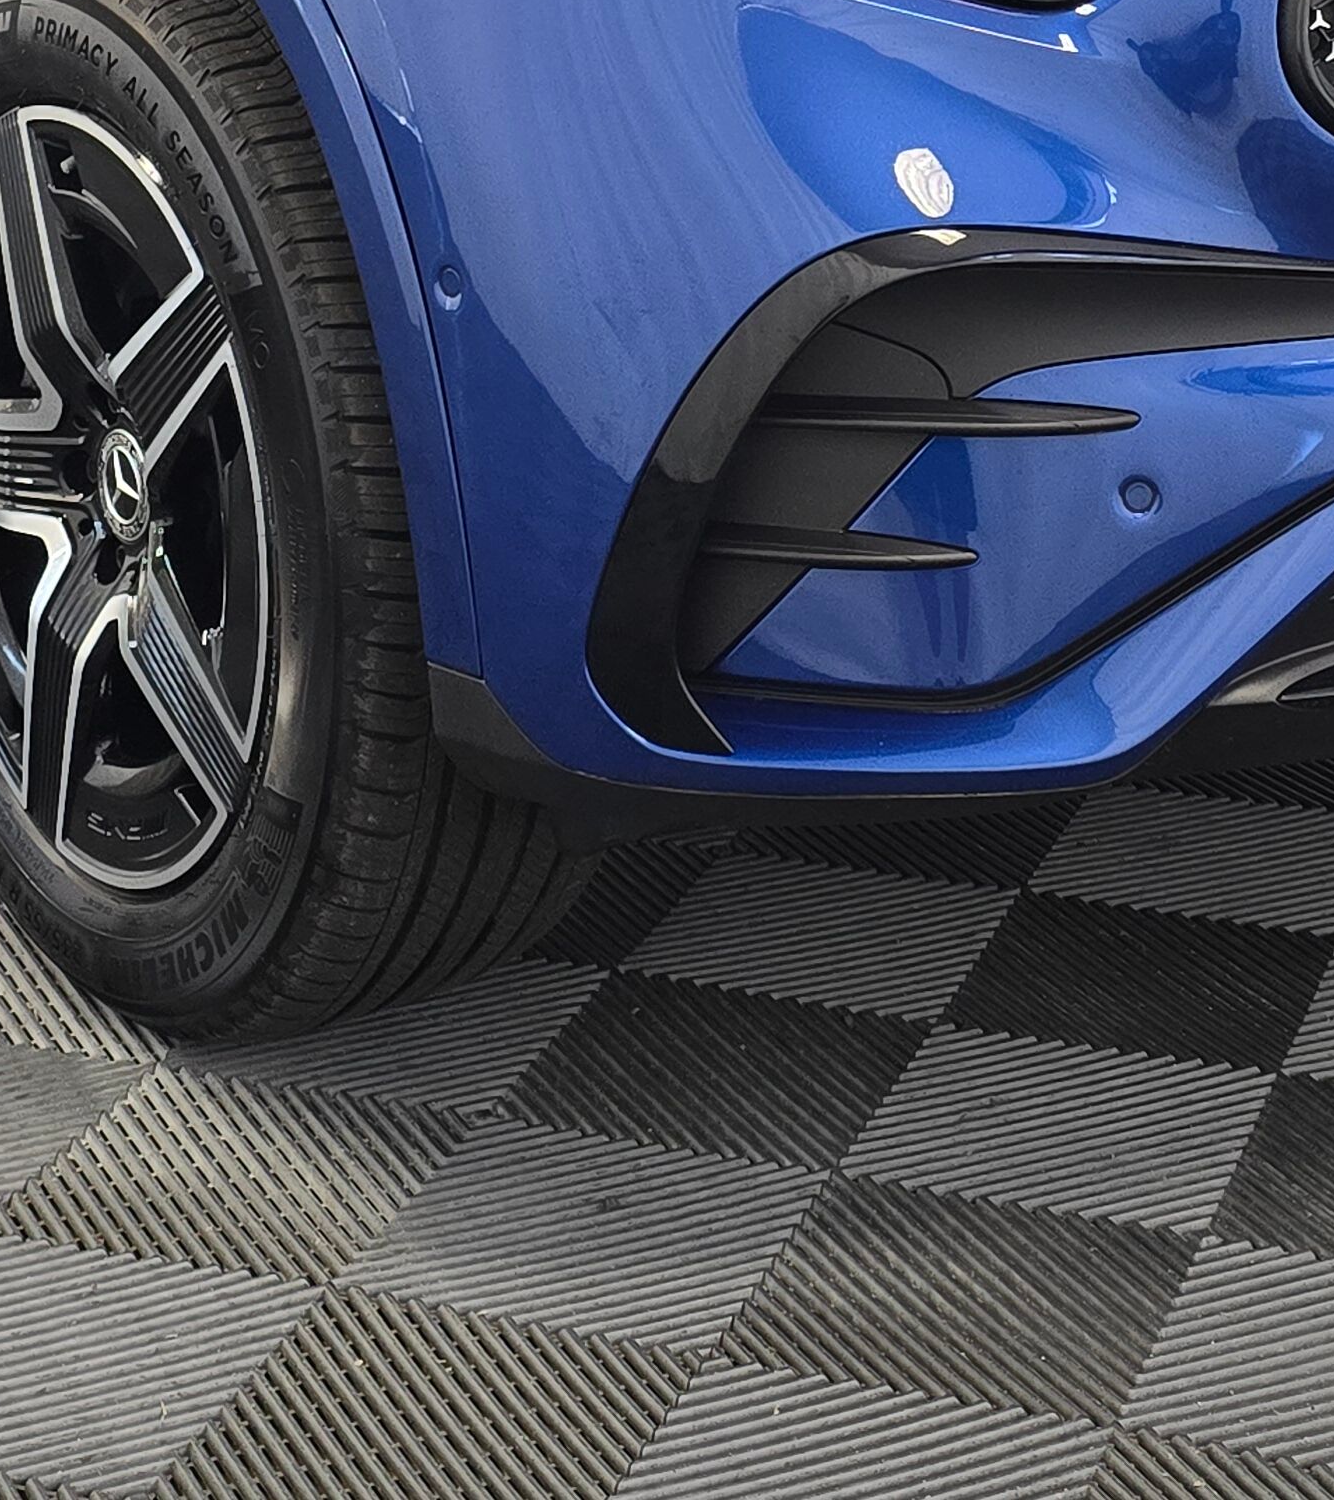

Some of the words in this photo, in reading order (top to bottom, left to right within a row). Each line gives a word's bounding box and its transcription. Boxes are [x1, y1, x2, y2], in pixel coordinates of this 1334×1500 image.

[33, 15, 119, 77] PRIMACY
[122, 76, 160, 128] ALL
[164, 129, 240, 265] SEASON
